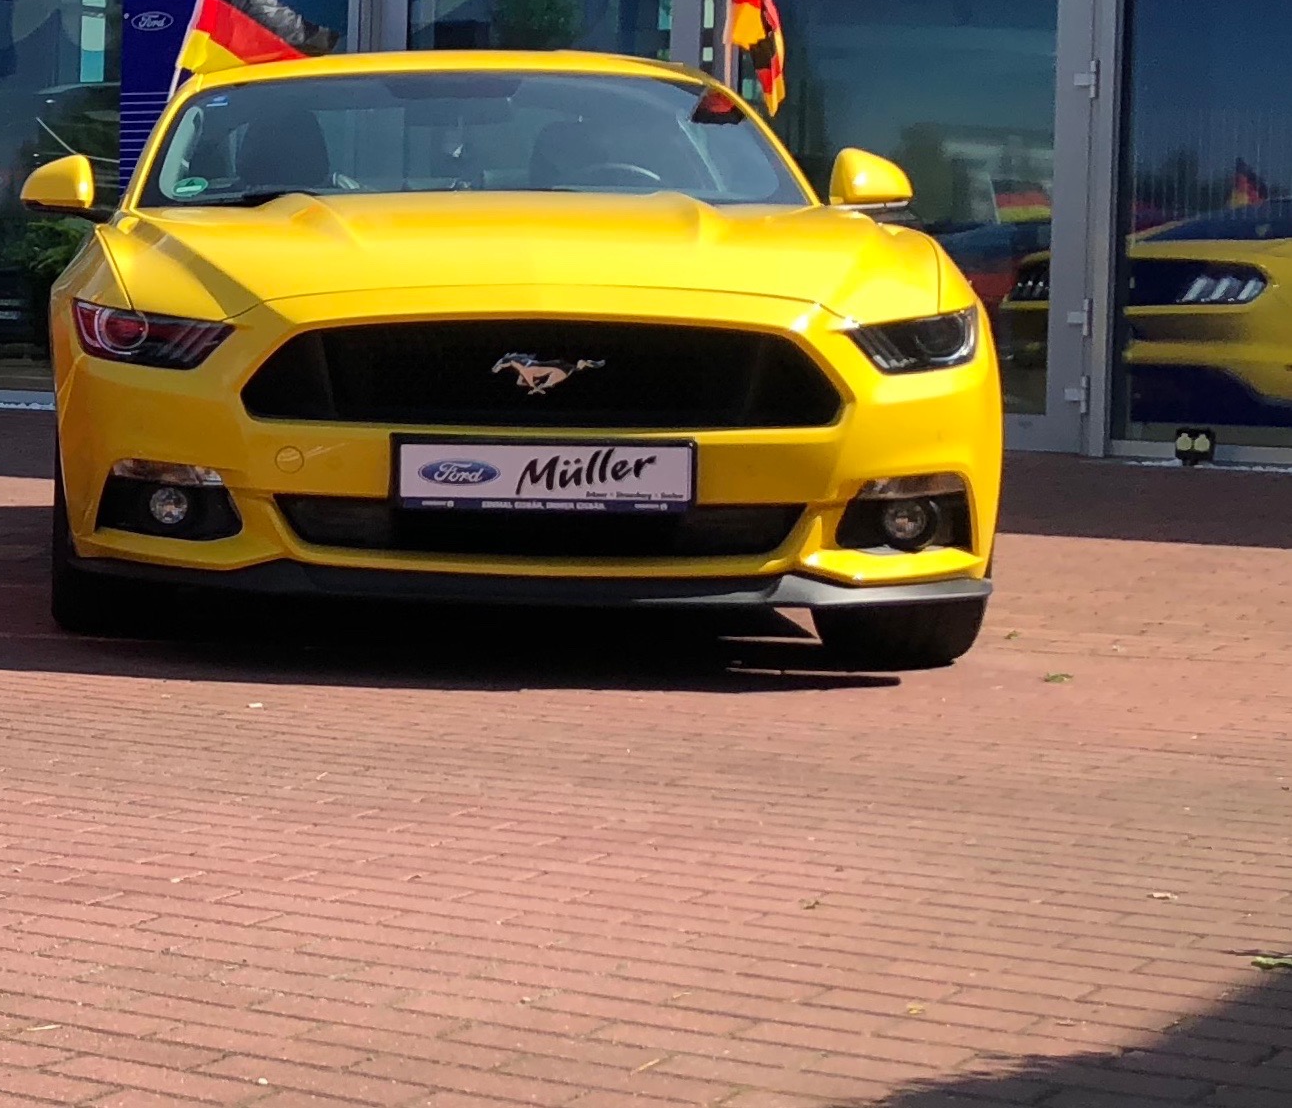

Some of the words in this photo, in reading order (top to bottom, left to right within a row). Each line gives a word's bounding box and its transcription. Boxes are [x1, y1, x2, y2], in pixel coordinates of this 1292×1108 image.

[138, 14, 166, 28] Ford
[433, 461, 484, 483] Ford
[514, 447, 657, 496] Müller
